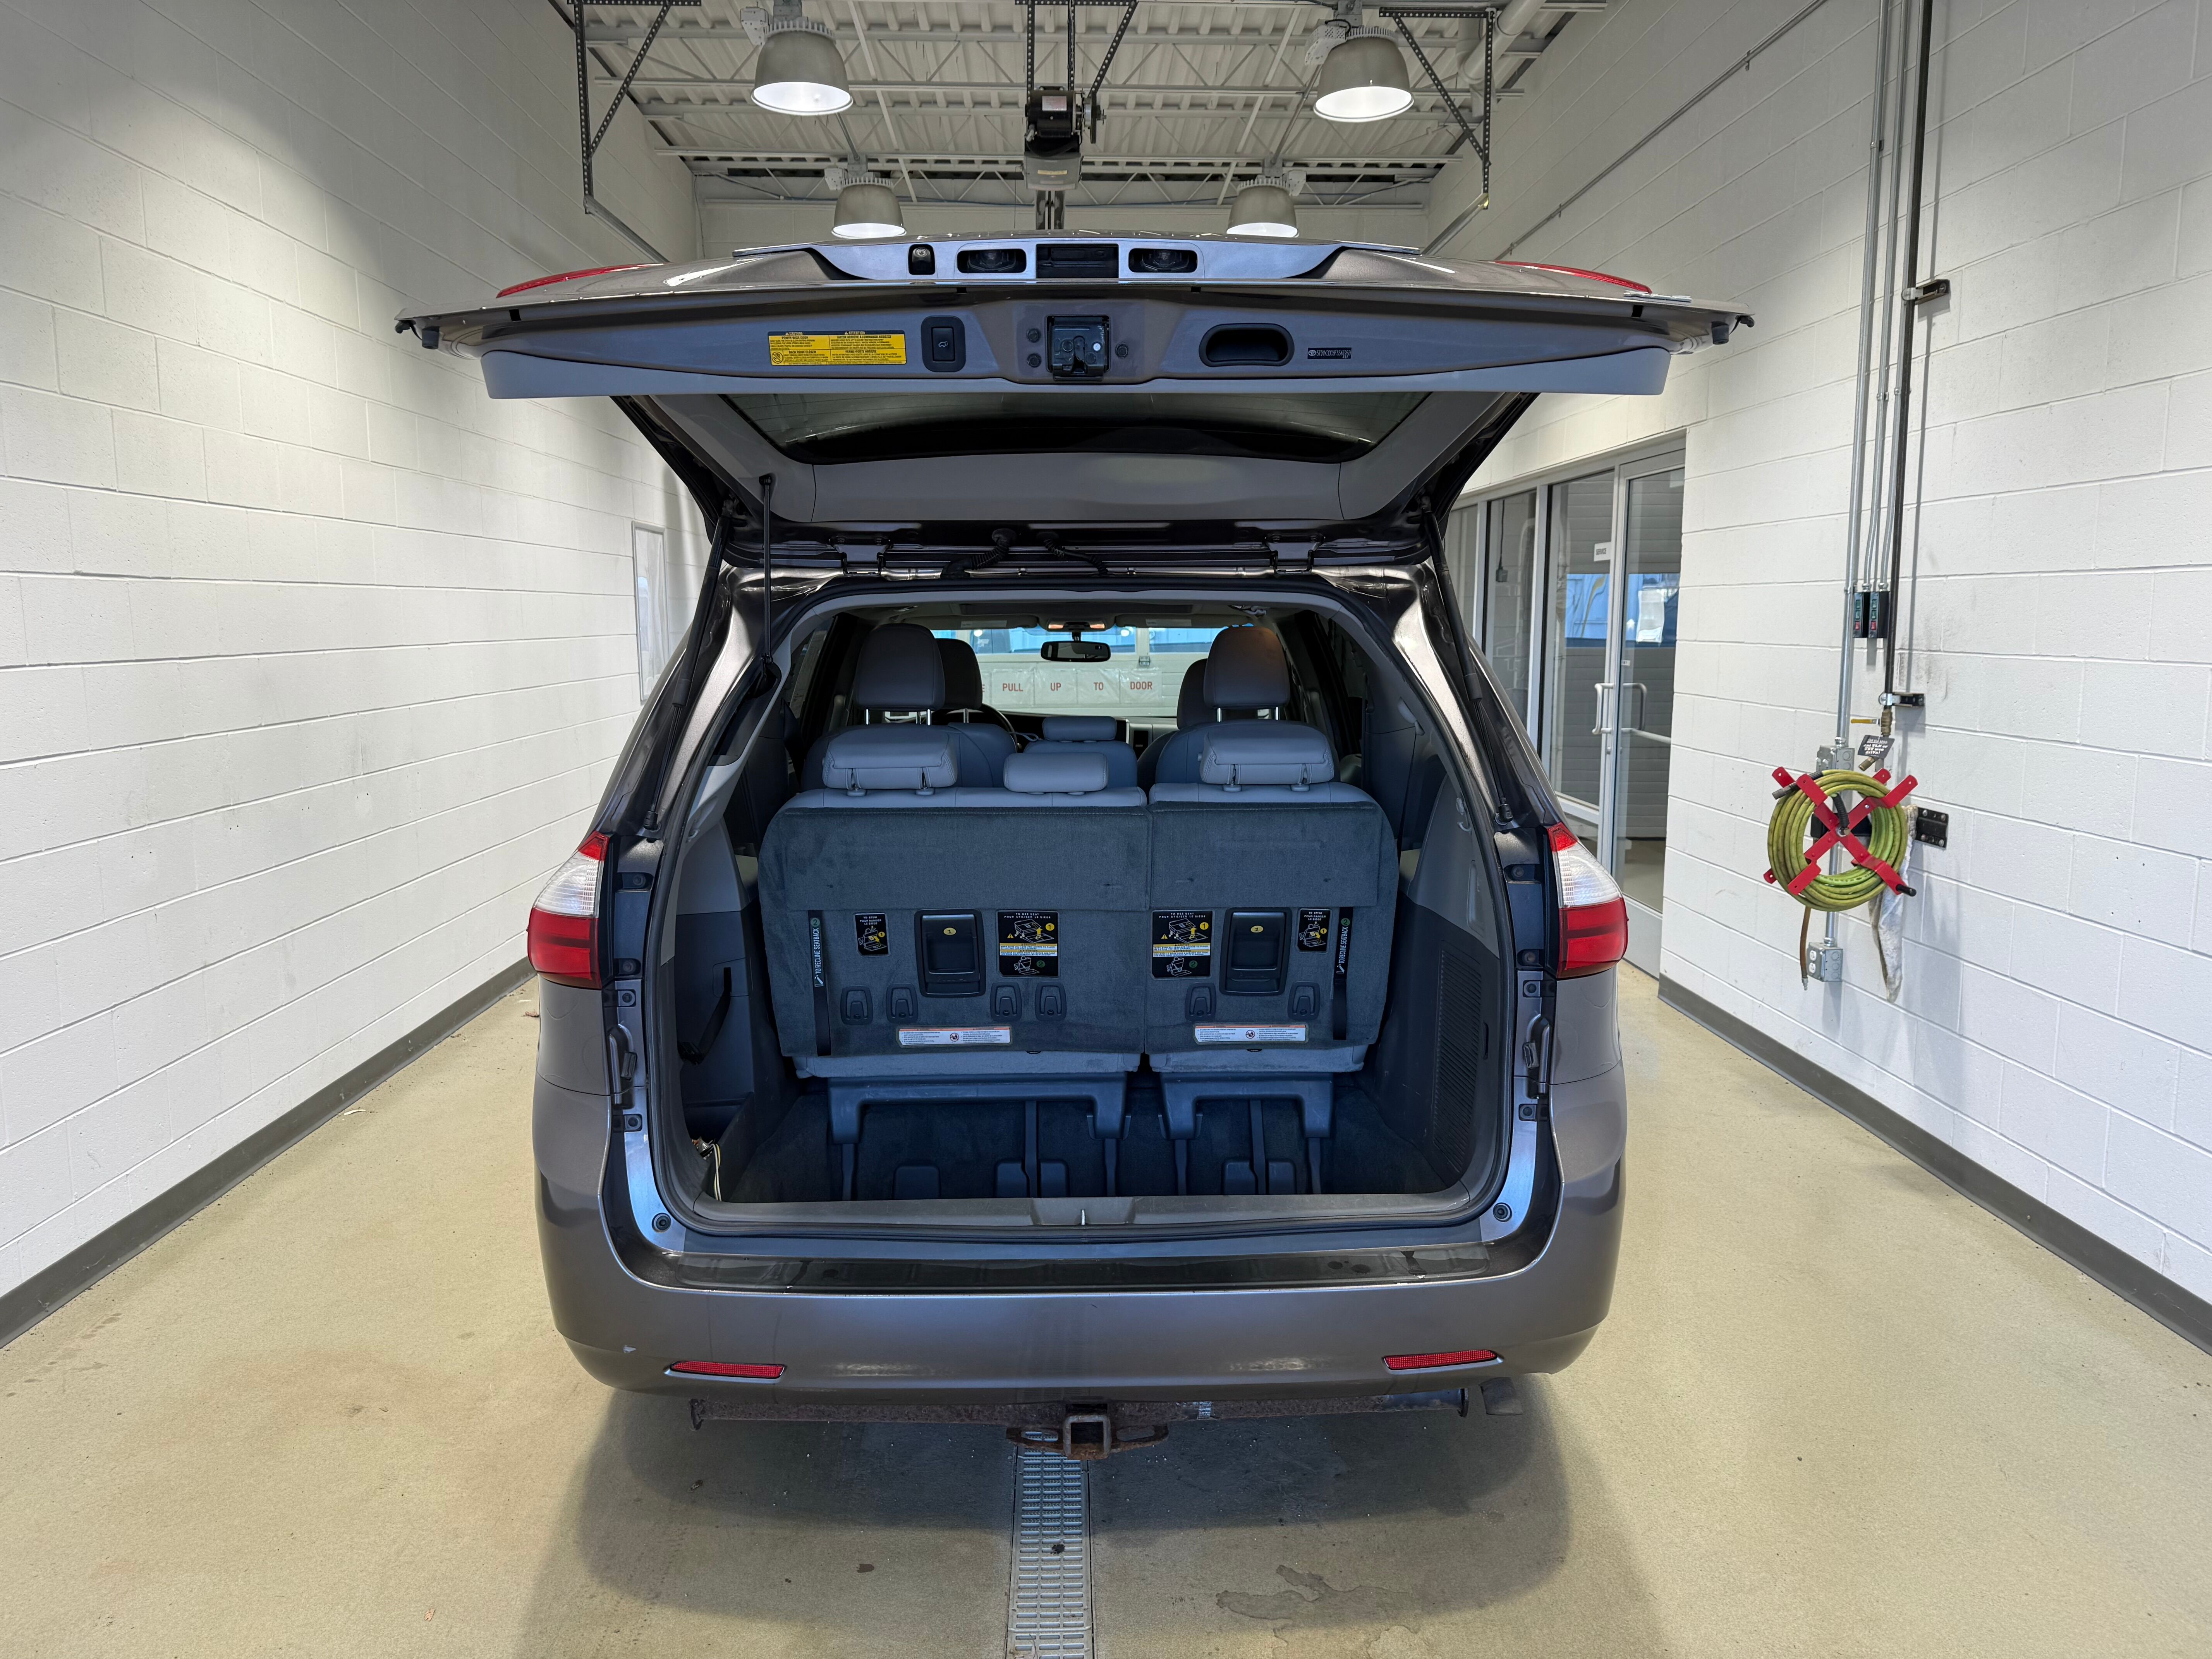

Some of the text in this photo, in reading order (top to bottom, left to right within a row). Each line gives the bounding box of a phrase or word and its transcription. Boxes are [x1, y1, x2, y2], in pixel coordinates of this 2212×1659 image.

[1003, 681, 1152, 691] PULL UP TO DOOR
